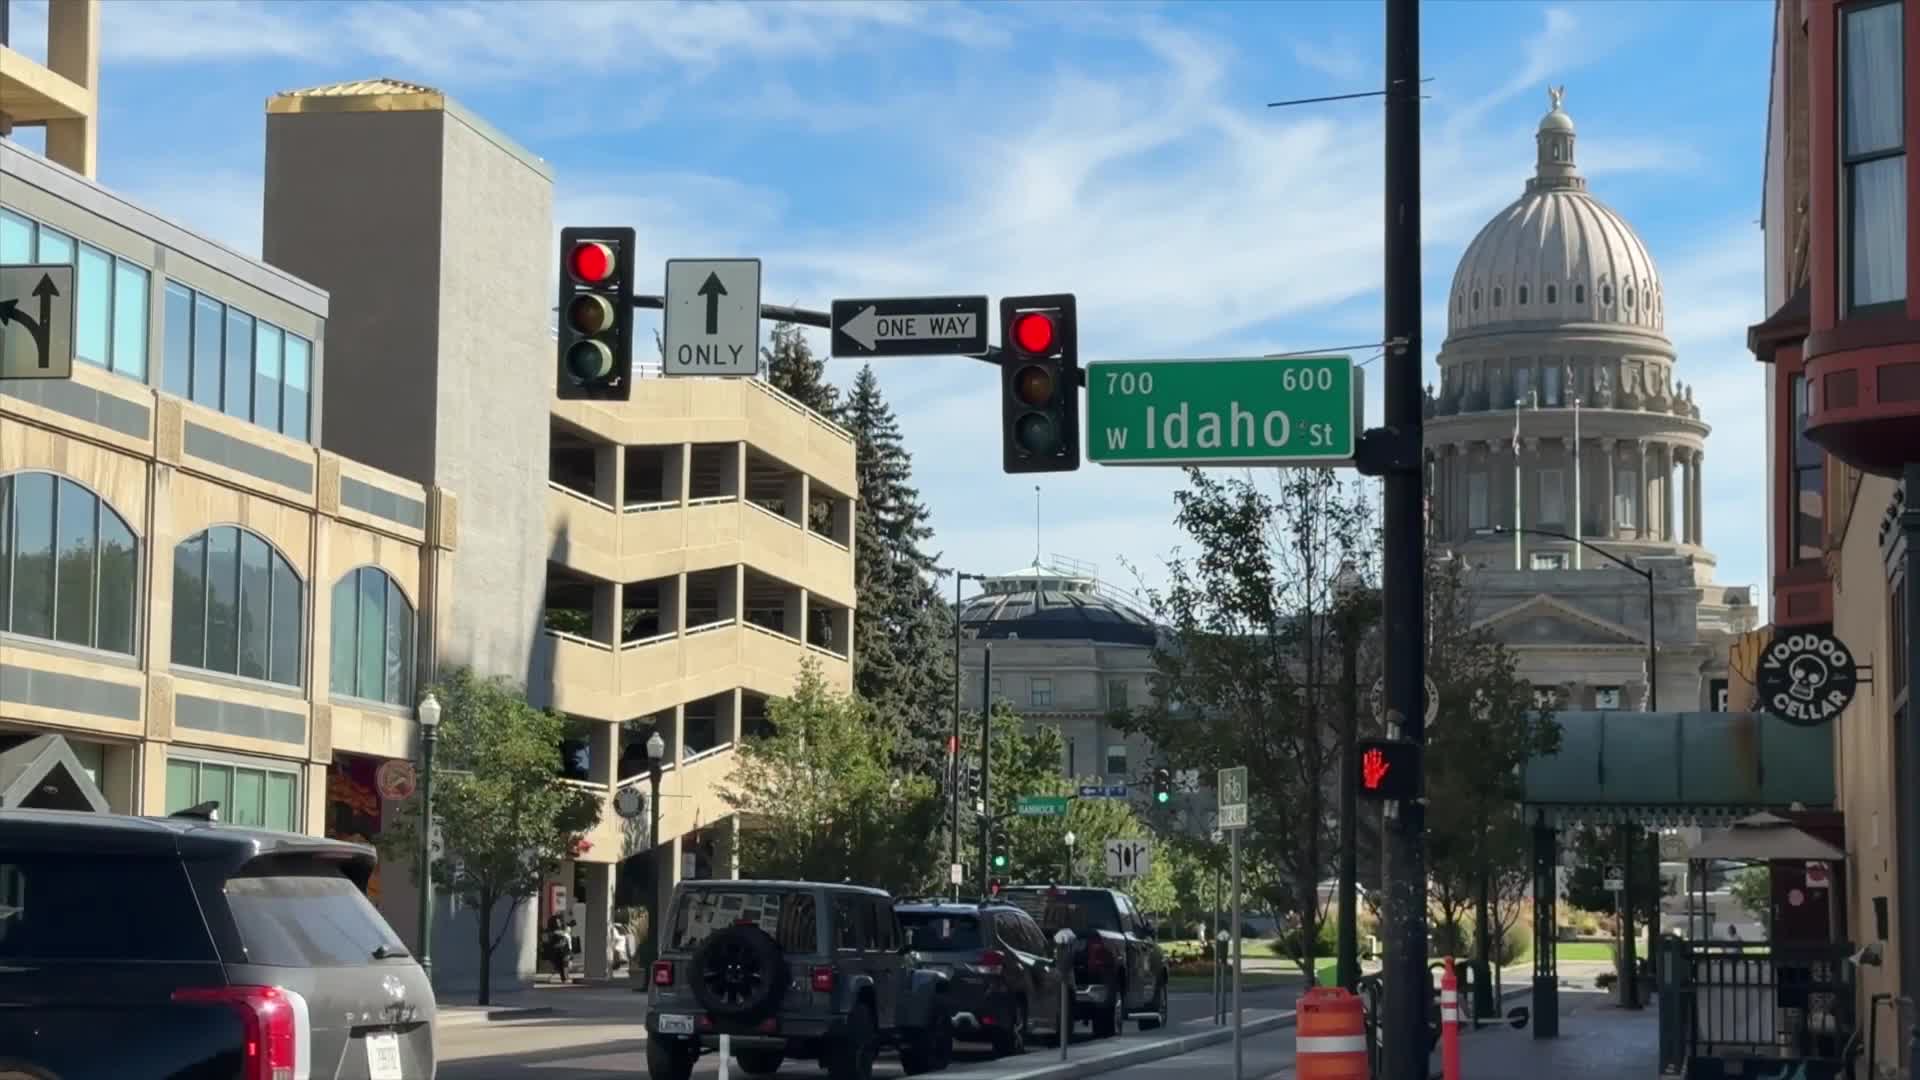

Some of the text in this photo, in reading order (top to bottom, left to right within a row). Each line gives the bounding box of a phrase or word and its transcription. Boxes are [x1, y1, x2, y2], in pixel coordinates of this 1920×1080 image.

[876, 316, 971, 337] ONE WAY
[677, 343, 744, 366] ONLY
[1106, 372, 1154, 395] 700
[1282, 368, 1333, 391] 600
[1106, 401, 1334, 450] W Idaho St
[1763, 633, 1848, 669] VOODOO
[1773, 690, 1847, 720] CELLAR
